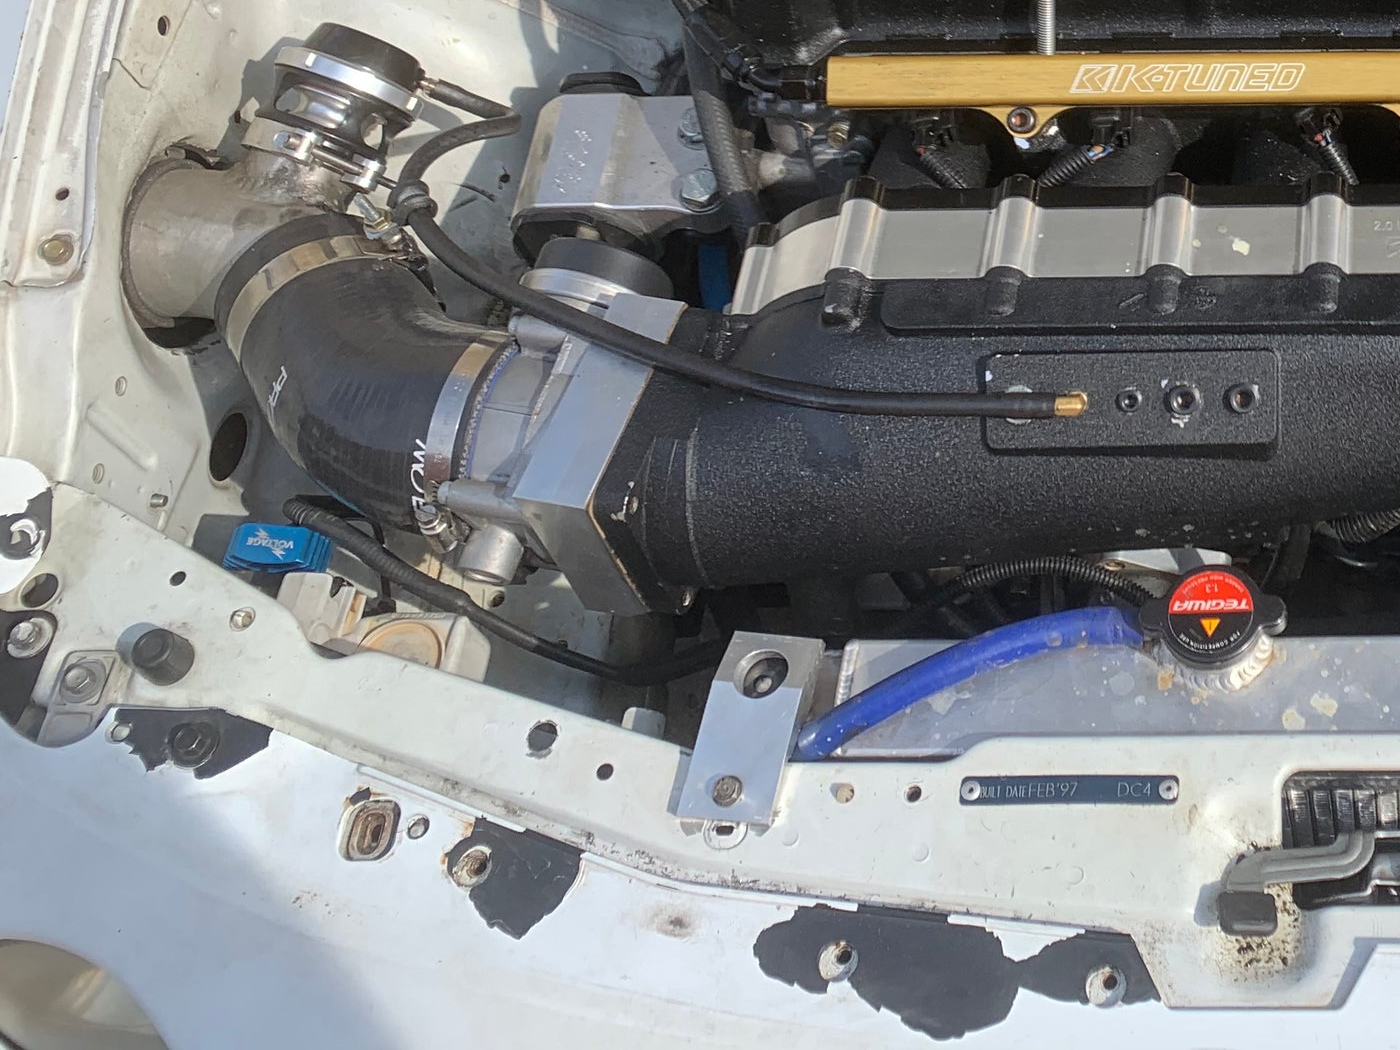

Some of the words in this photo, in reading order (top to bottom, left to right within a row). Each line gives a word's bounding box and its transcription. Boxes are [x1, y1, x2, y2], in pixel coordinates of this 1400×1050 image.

[1373, 220, 1393, 231] 2.0
[246, 536, 295, 550] VOLTAGE
[1173, 598, 1249, 611] TEGIWA
[1229, 630, 1241, 641] FOR
[980, 785, 1001, 799] BUILT
[1006, 785, 1028, 799] DATE
[1028, 782, 1079, 798] FEB'97
[1117, 782, 1152, 798] DC4
